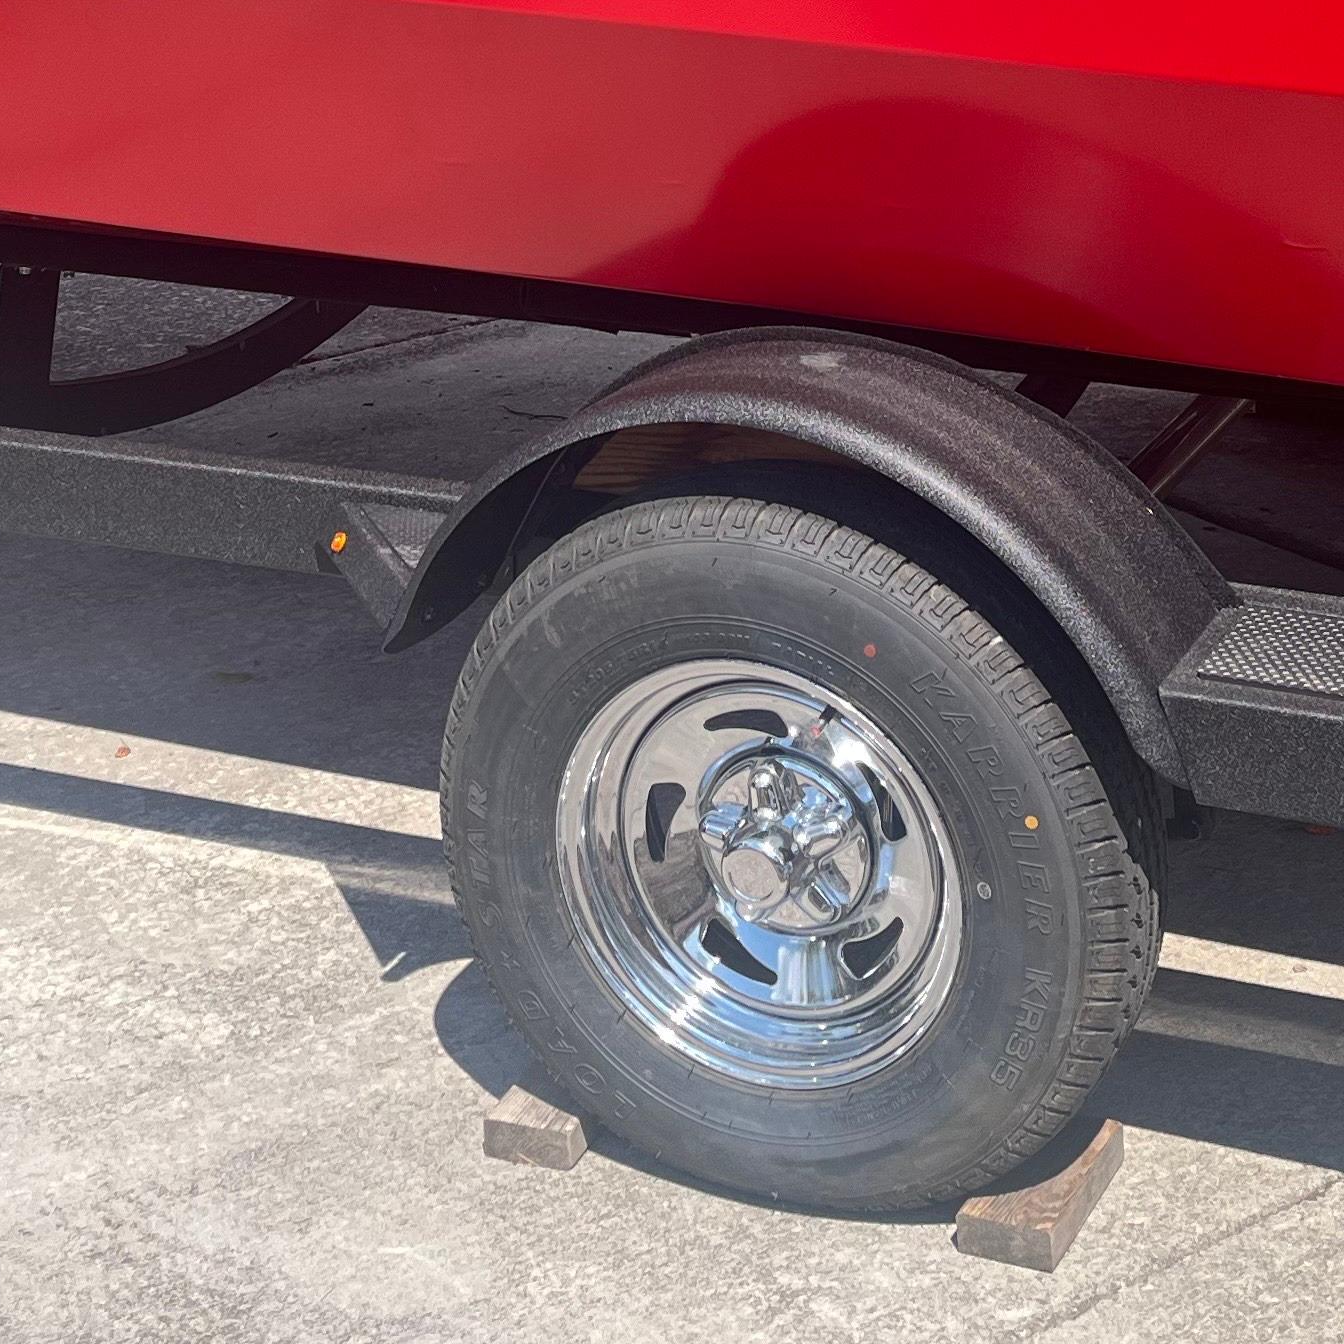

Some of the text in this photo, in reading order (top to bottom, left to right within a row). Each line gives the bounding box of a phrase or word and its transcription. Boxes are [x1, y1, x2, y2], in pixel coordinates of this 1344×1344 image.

[467, 781, 638, 1119] LOAD STAR
[909, 670, 1056, 936] KARRIER
[989, 967, 1054, 1091] KR35
